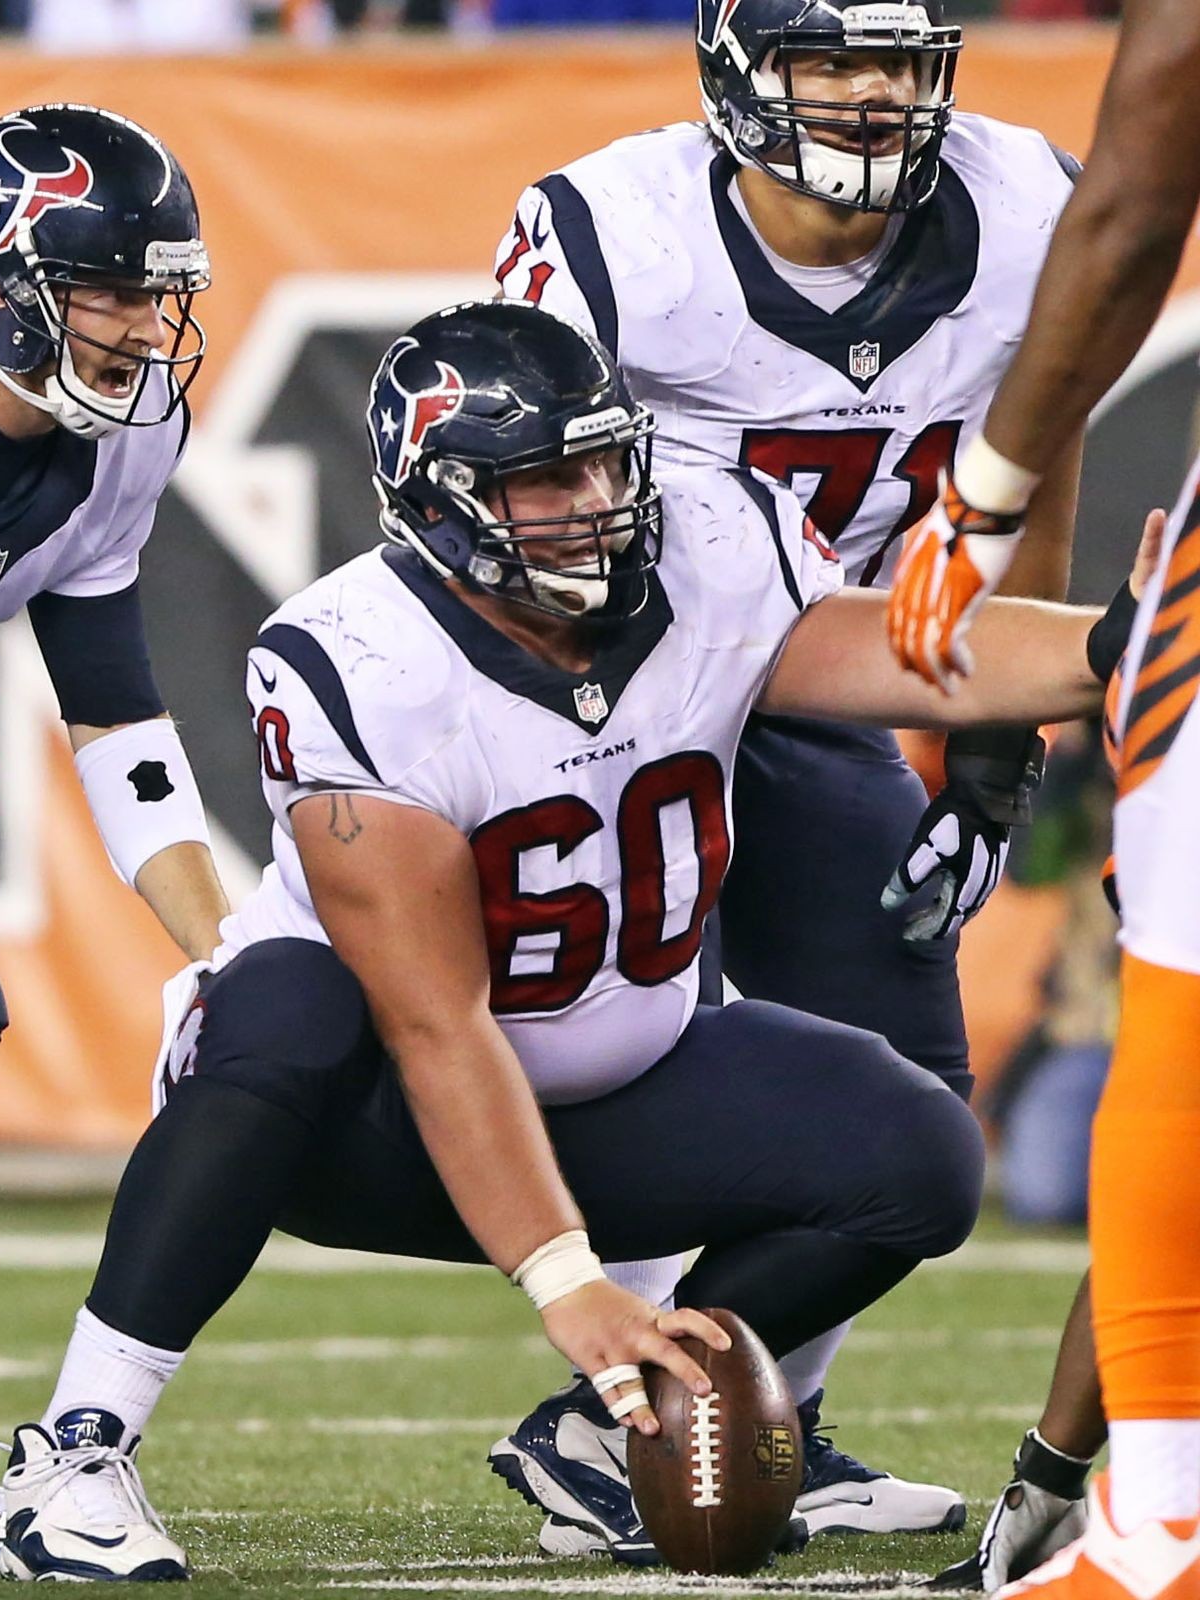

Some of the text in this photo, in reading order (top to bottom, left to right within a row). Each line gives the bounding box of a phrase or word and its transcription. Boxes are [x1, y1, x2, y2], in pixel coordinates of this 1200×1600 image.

[853, 357, 876, 374] NFL
[580, 415, 623, 432] TEXANS
[819, 404, 906, 418] TEXANS
[738, 420, 964, 587] 71
[248, 702, 298, 783] 0
[553, 737, 636, 773] TEXANS
[471, 749, 734, 1014] 60
